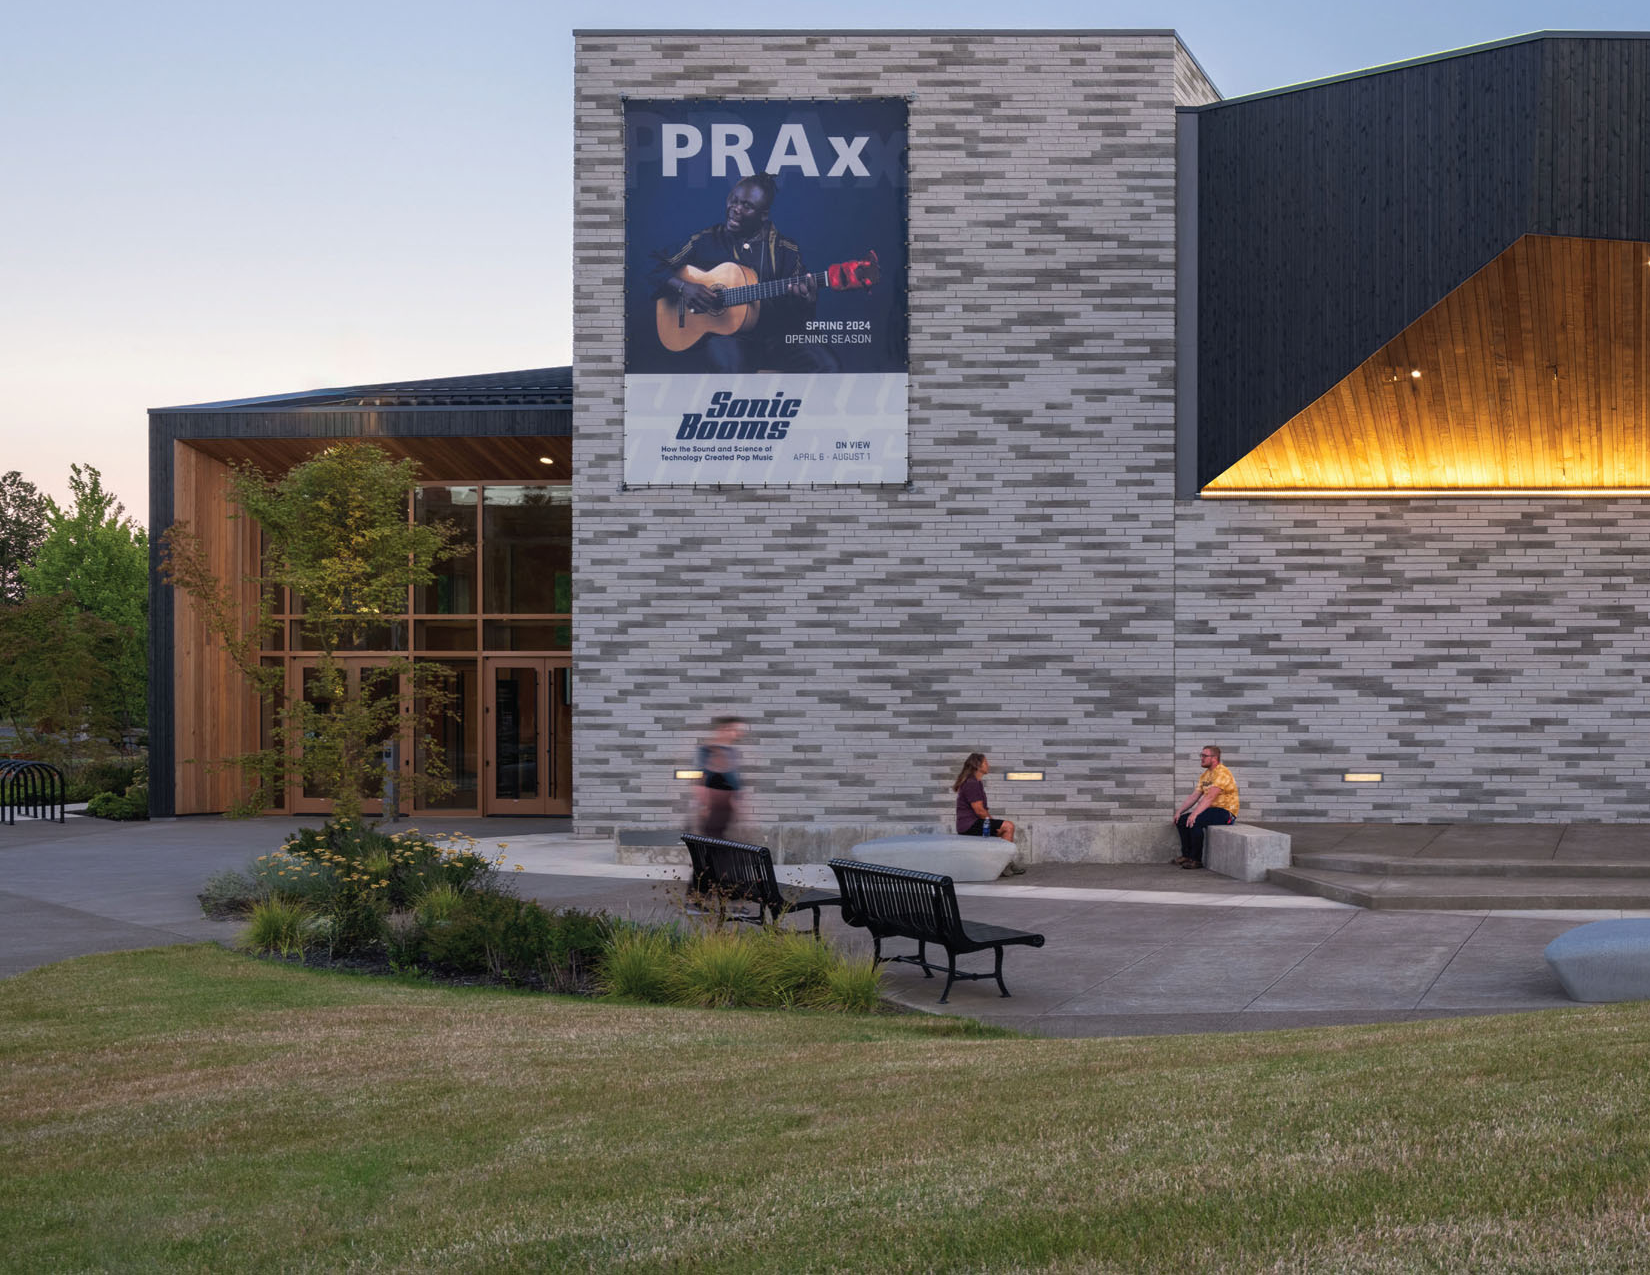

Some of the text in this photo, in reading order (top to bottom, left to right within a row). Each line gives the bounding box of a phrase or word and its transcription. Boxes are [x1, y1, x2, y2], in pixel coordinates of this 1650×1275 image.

[661, 123, 871, 177] PRAx
[805, 321, 872, 331] SPRING 2024
[785, 334, 872, 344] OPENING SEASON
[705, 391, 802, 418] Sonic
[675, 413, 791, 440] Booms
[679, 445, 692, 453] the
[692, 445, 716, 453] Sound
[717, 445, 732, 453] and
[734, 445, 763, 453] Science
[764, 445, 773, 453] of
[835, 441, 871, 449] ON VIEW
[661, 454, 703, 462] Technology
[736, 454, 751, 462] Pop
[793, 453, 817, 461] APRIL
[832, 453, 865, 461] AUGUST
